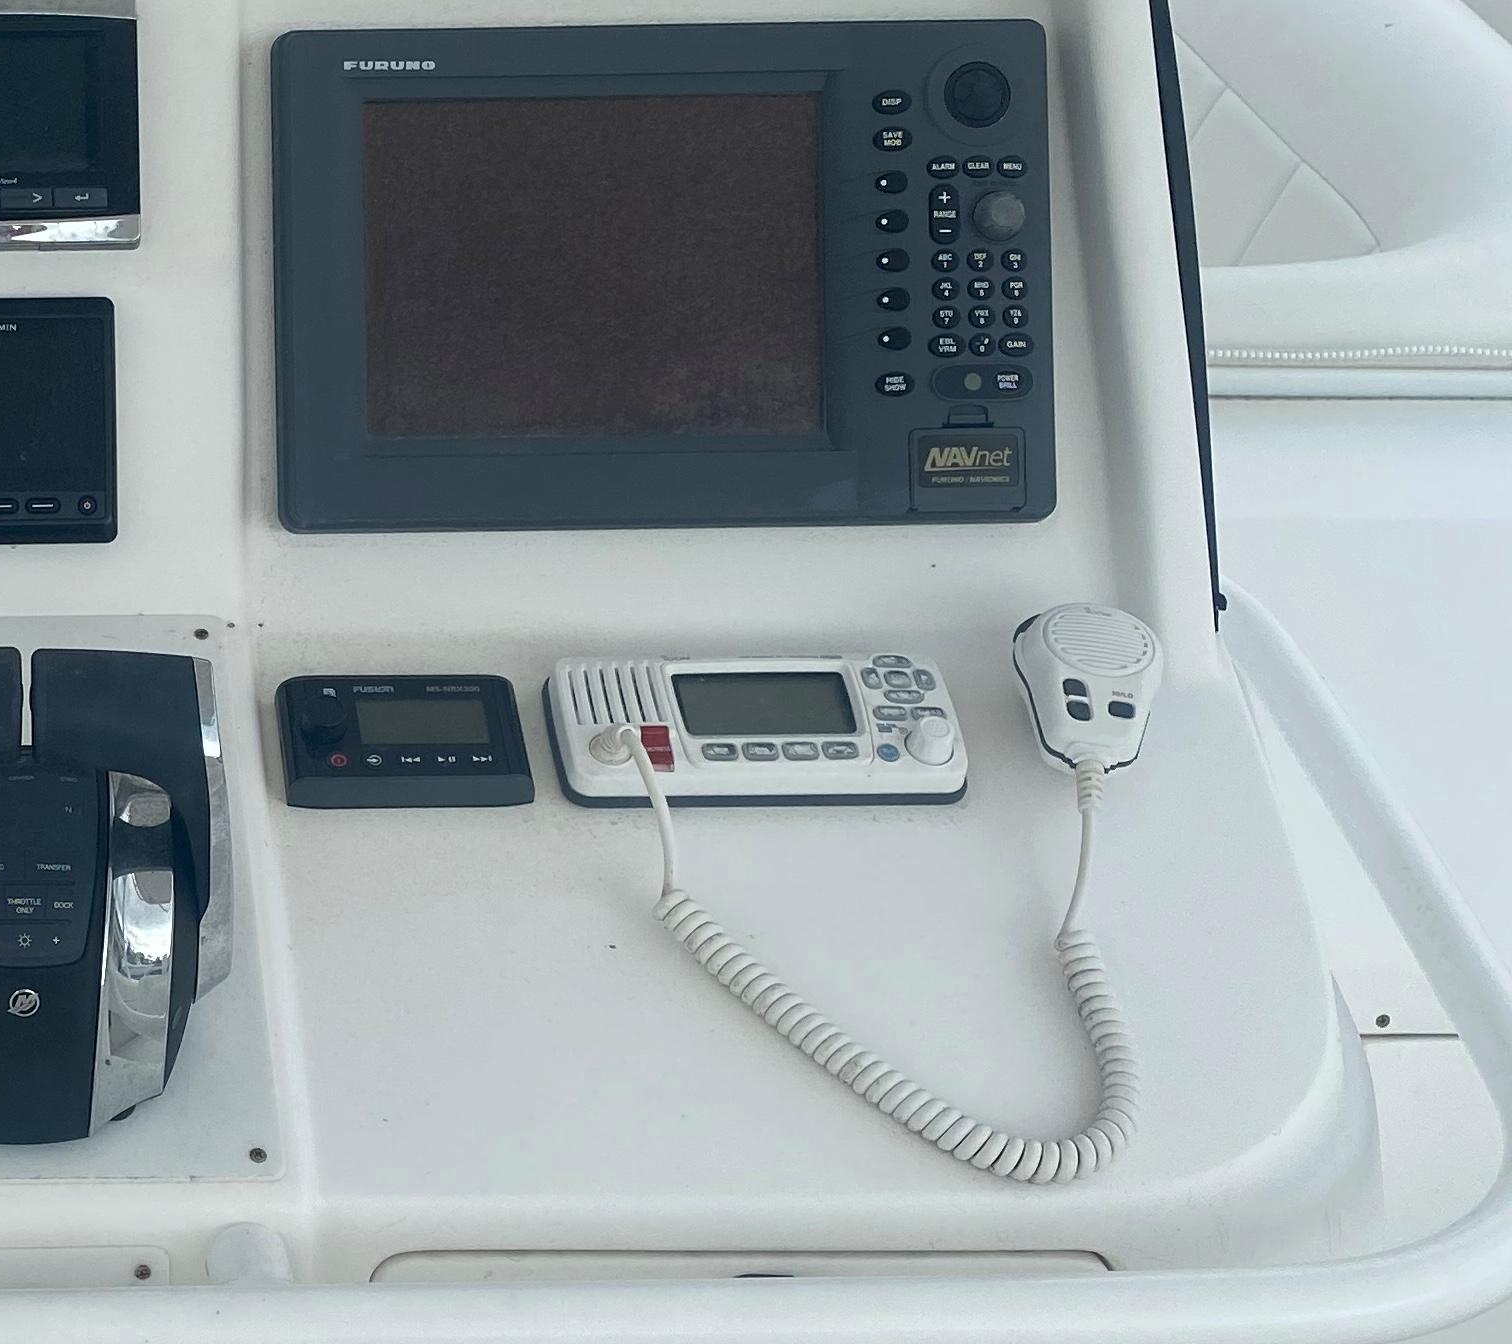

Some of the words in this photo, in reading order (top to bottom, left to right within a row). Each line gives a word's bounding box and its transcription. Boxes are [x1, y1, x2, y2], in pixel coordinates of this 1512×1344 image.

[343, 60, 436, 71] FURUNO
[881, 98, 902, 106] DISP
[882, 131, 904, 139] SAVE
[1003, 162, 1023, 171] MENU
[933, 210, 957, 218] RANGE
[938, 253, 953, 261] ABC
[939, 337, 956, 345] EBL
[1006, 340, 1027, 348] GAIN
[938, 345, 957, 353] VRM
